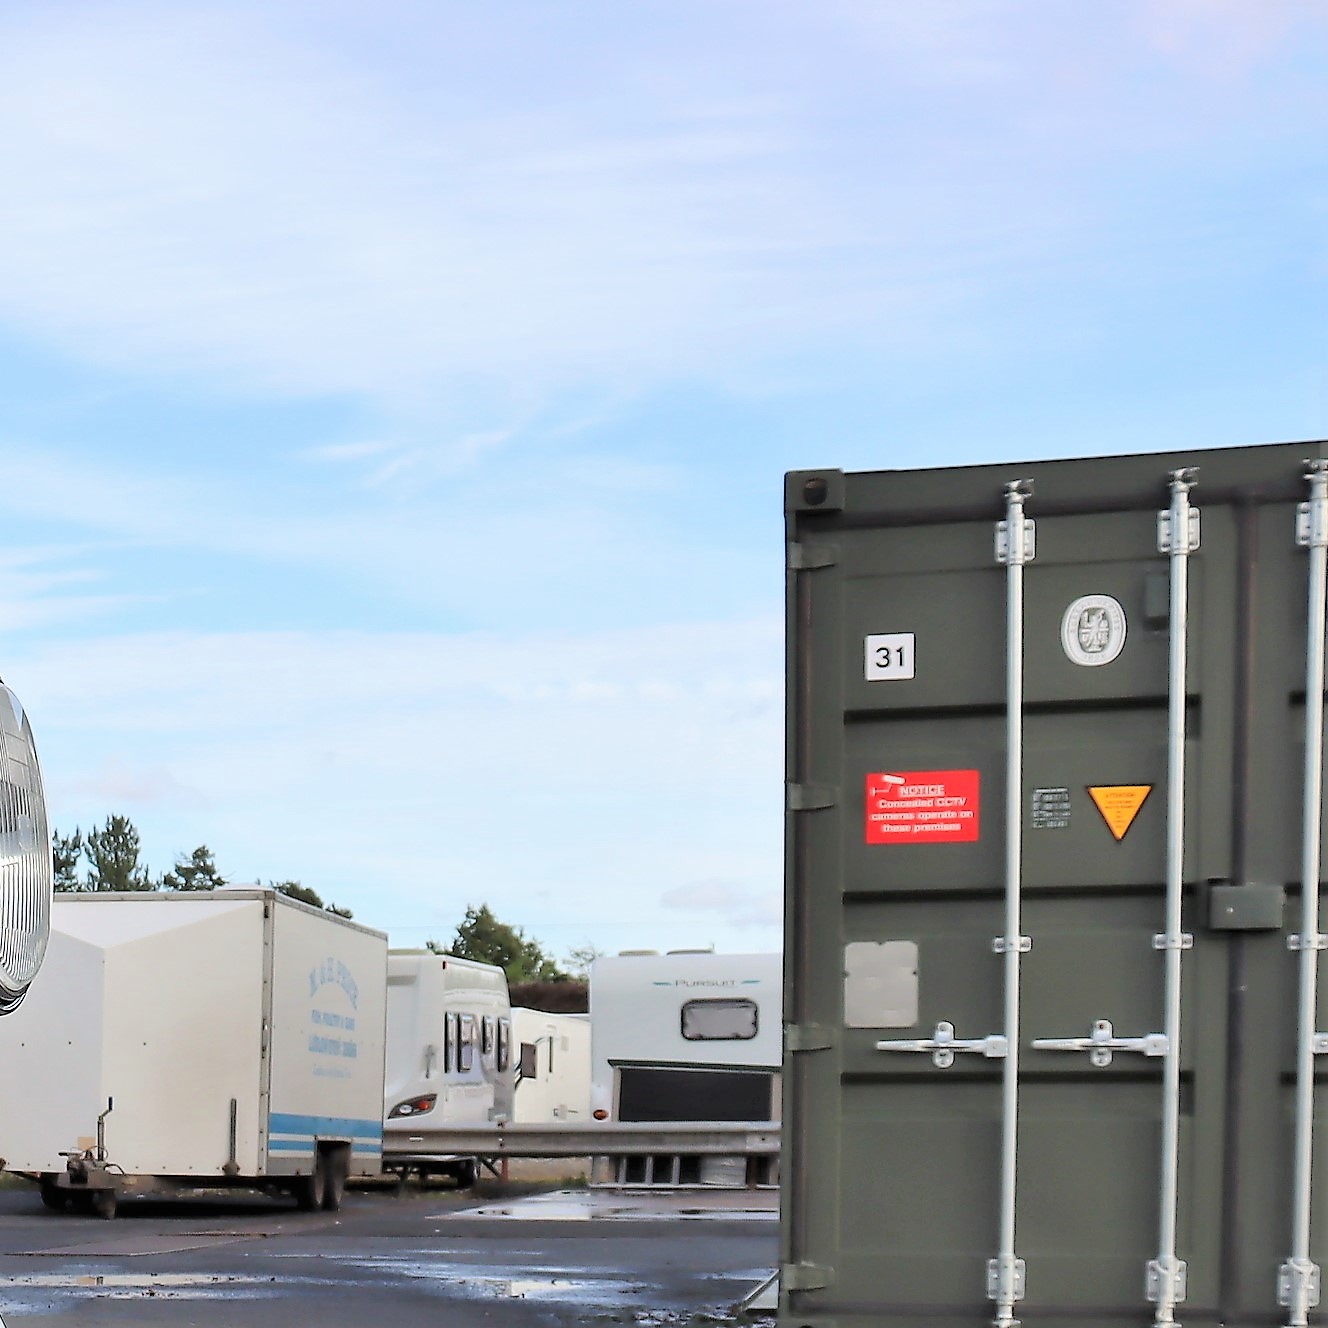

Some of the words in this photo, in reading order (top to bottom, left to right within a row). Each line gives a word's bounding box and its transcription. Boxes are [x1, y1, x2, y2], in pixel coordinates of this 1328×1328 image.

[876, 647, 904, 668] 31
[899, 785, 945, 796] NOTICE
[879, 799, 934, 808] Concealed
[936, 797, 966, 807] CCTV
[872, 812, 915, 821] cameras
[917, 811, 958, 821] operate
[882, 824, 911, 833] these
[913, 823, 962, 833] premises
